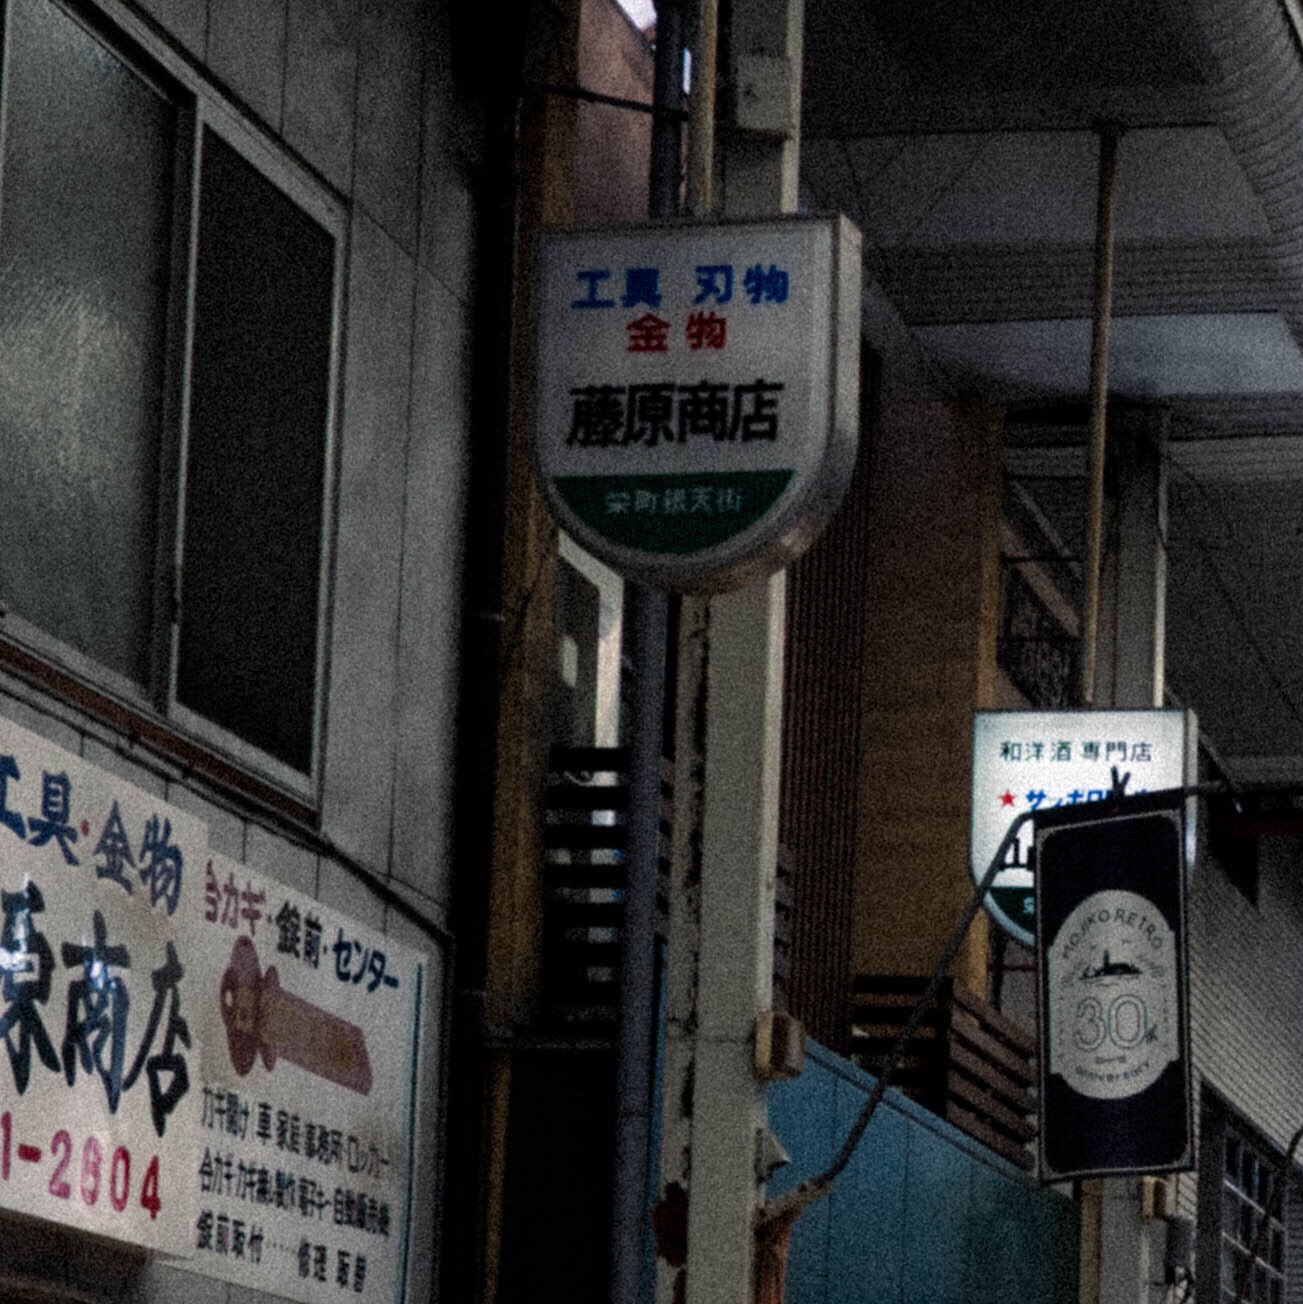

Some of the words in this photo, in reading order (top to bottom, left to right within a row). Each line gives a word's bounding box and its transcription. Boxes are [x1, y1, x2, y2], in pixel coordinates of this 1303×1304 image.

[572, 267, 662, 308] 工具
[693, 263, 789, 304] 刃物
[626, 311, 726, 352] 金物
[566, 377, 784, 448] 藤原商店
[1000, 741, 1153, 763] 和洋酒専門店
